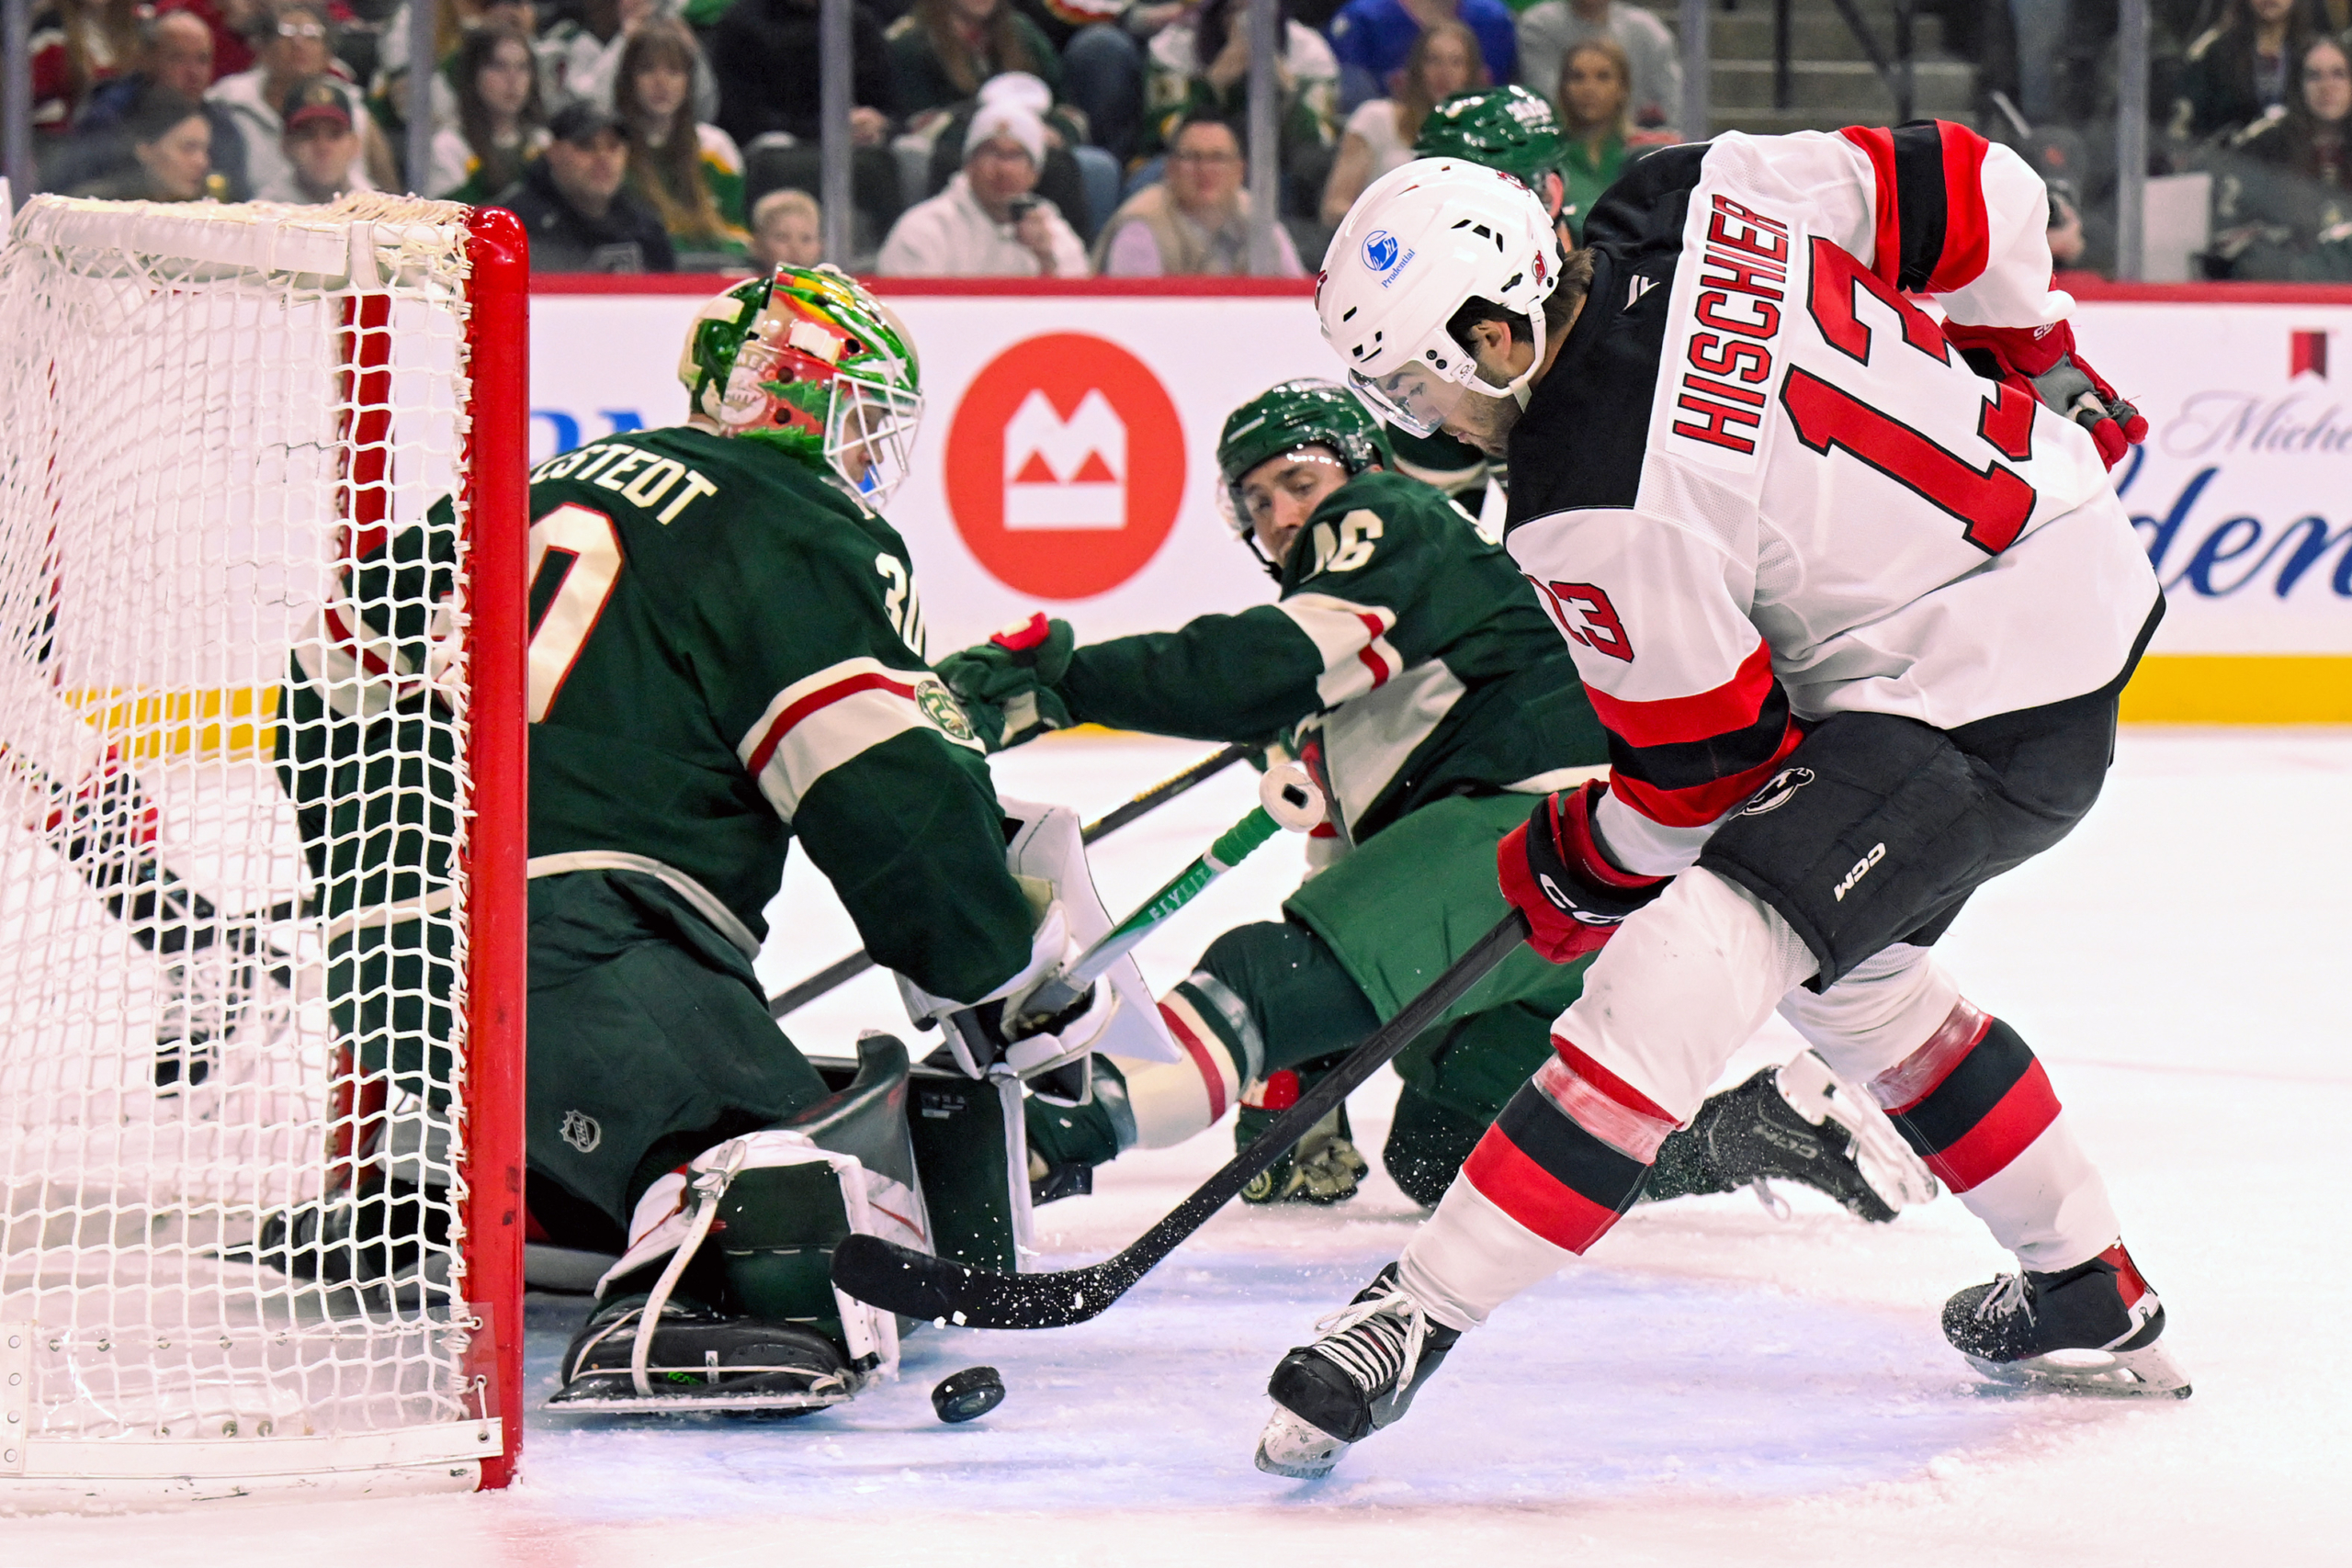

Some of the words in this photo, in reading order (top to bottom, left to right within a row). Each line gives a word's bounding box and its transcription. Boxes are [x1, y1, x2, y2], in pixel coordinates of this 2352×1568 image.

[1381, 248, 1416, 288] Prudential
[1672, 194, 1790, 456] HISCHIER
[1779, 233, 2039, 557] 13
[2117, 445, 2352, 600] den
[1539, 873, 1624, 925] CC
[1833, 841, 1886, 902] CCM
